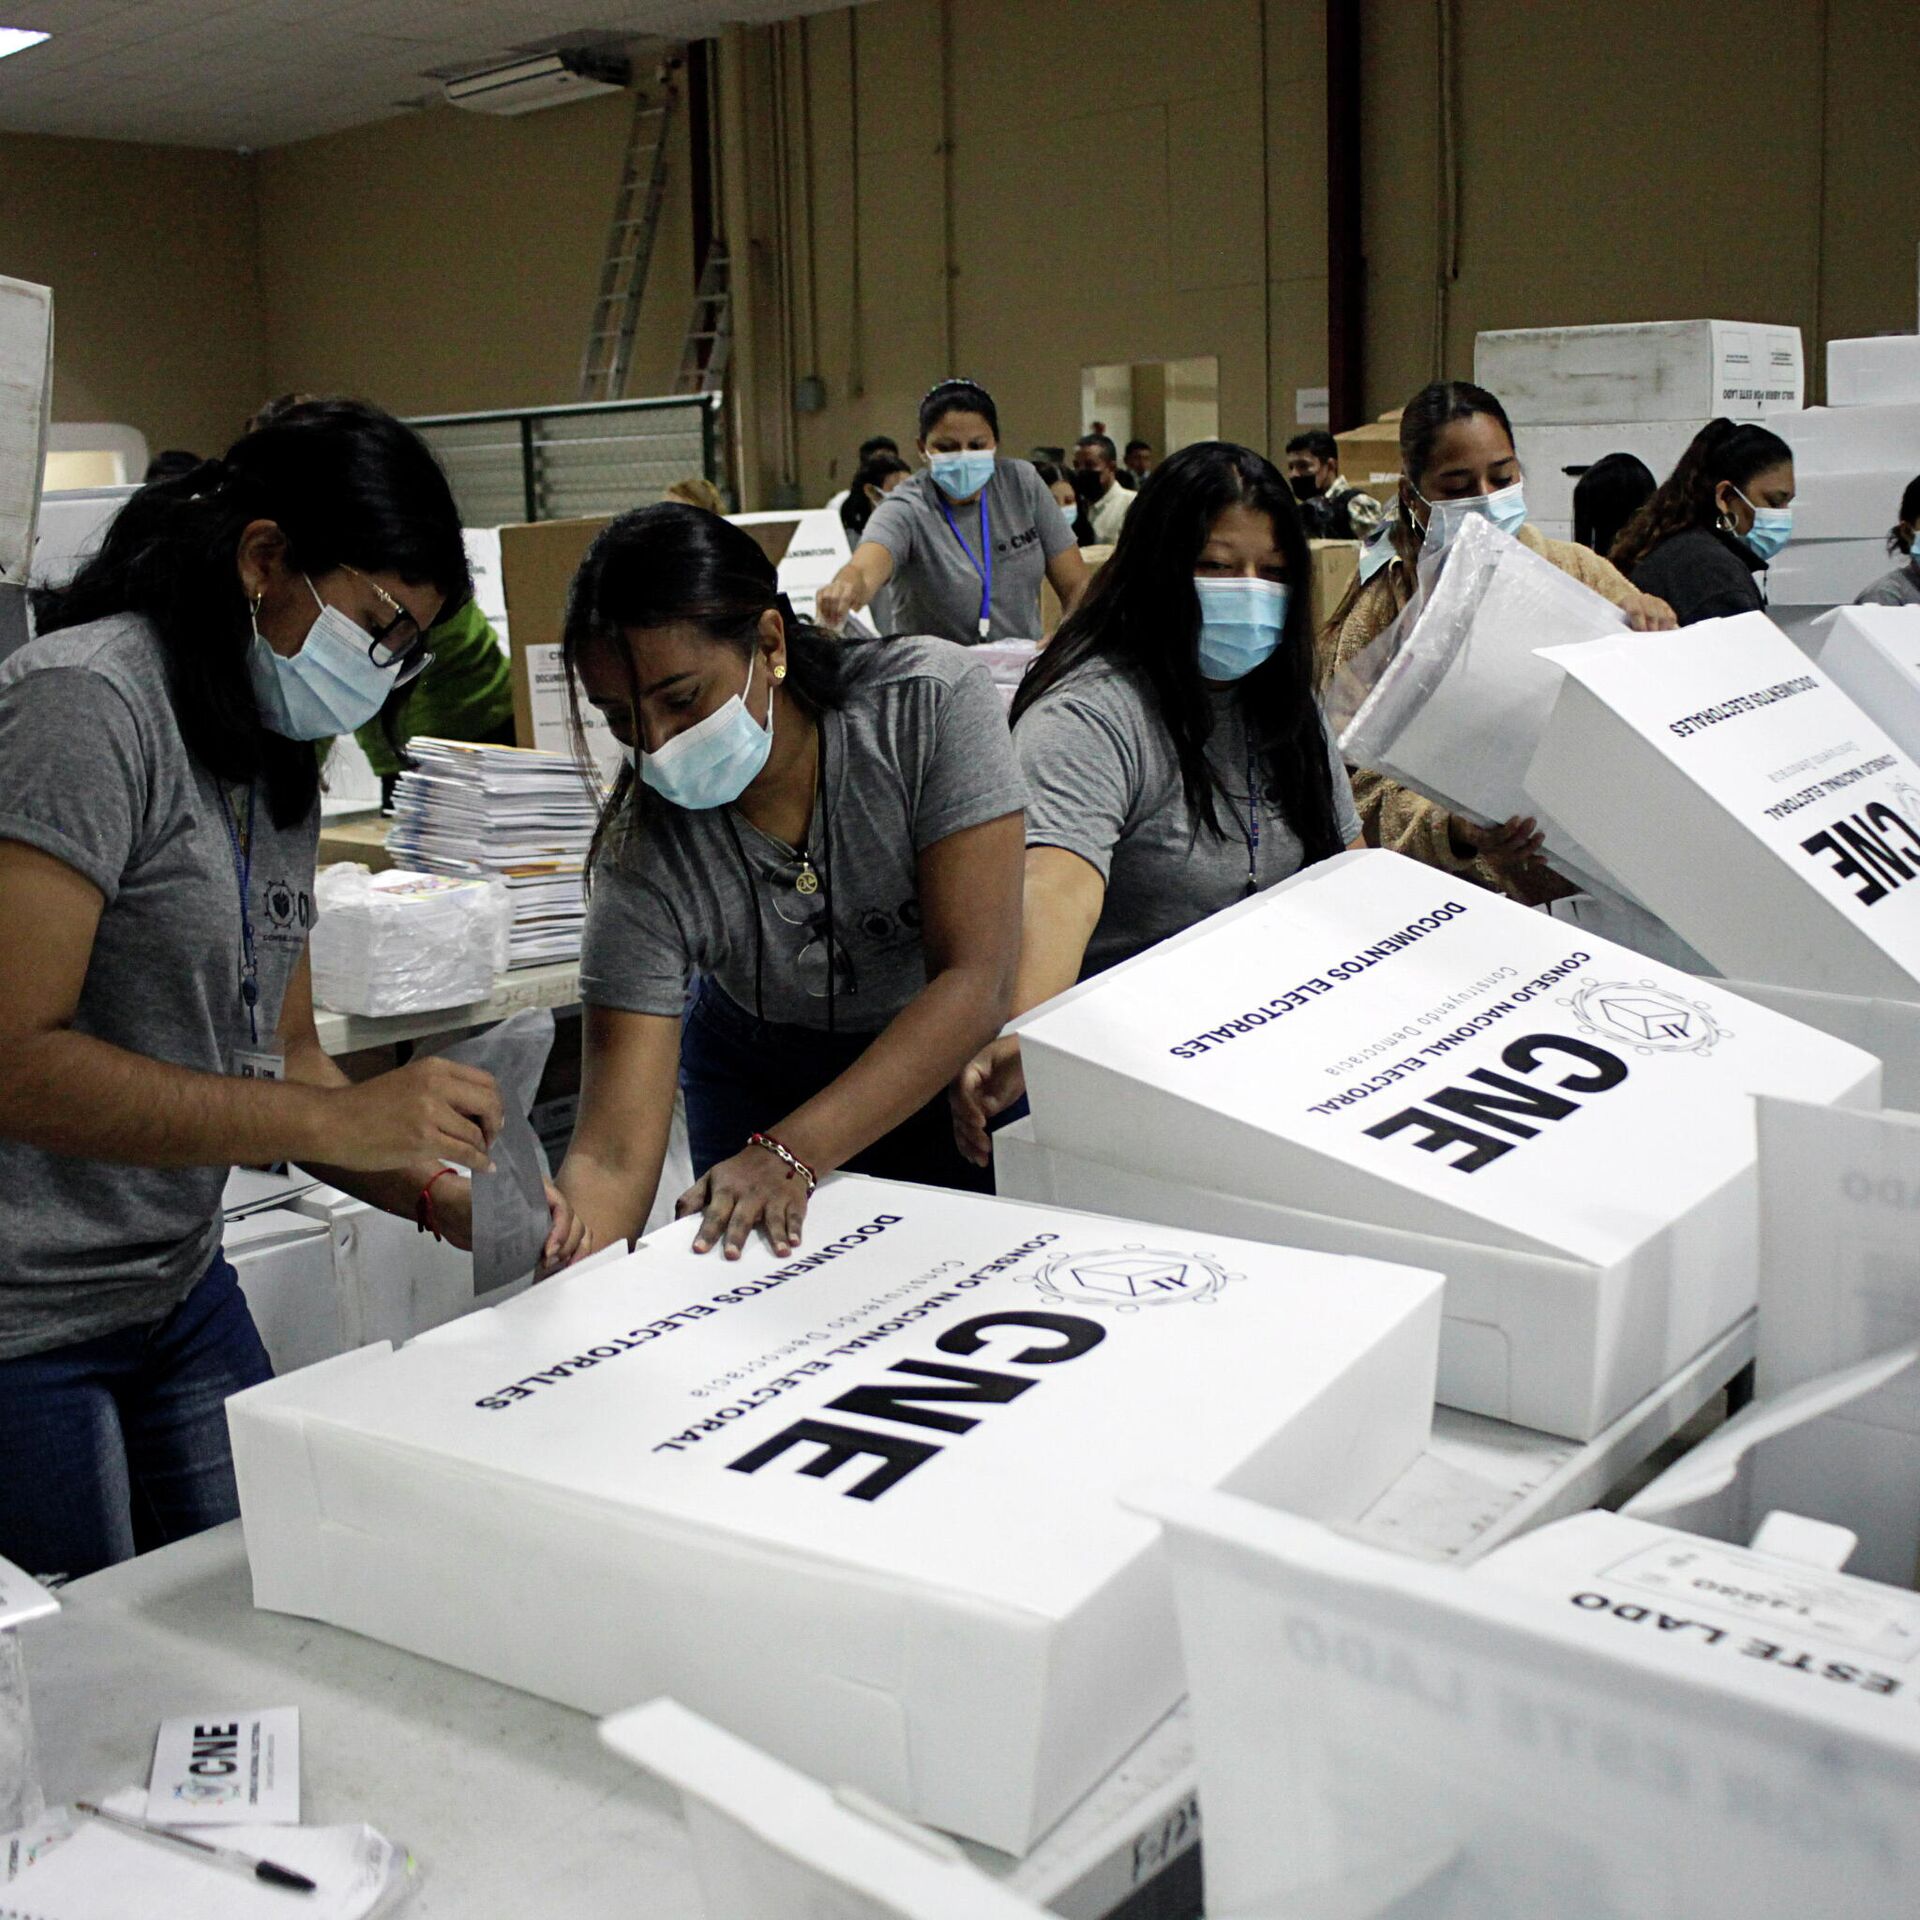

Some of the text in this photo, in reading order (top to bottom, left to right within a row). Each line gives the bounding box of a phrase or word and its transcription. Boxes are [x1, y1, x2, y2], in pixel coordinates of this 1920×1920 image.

[1723, 389, 1738, 399] LADO
[785, 548, 835, 558] DOCUMENT
[1668, 675, 1820, 738] DOCUMENTOS ELECTORALES
[1763, 754, 1898, 821] CONSEJO NACIONAL ELECTORAL
[1800, 802, 1920, 907] CNE
[1170, 901, 1467, 1059] DOCUMENTOS ELECTORALES
[1307, 951, 1591, 1117] CONSEJO NACIONAL ELECTORAL
[1323, 966, 1518, 1076] Construyendo Democracia
[1361, 1033, 1629, 1174] CNE
[475, 1214, 903, 1410] DOCUMENTOS ELECTORALES
[652, 1233, 1060, 1453] CONSEJO NACIONAL ELECTORAL
[690, 1259, 965, 1397] Construyendo Democracia
[725, 1310, 1107, 1502] CNE
[1570, 1592, 1901, 1696] ESTE LADO
[189, 1723, 238, 1777] CNE
